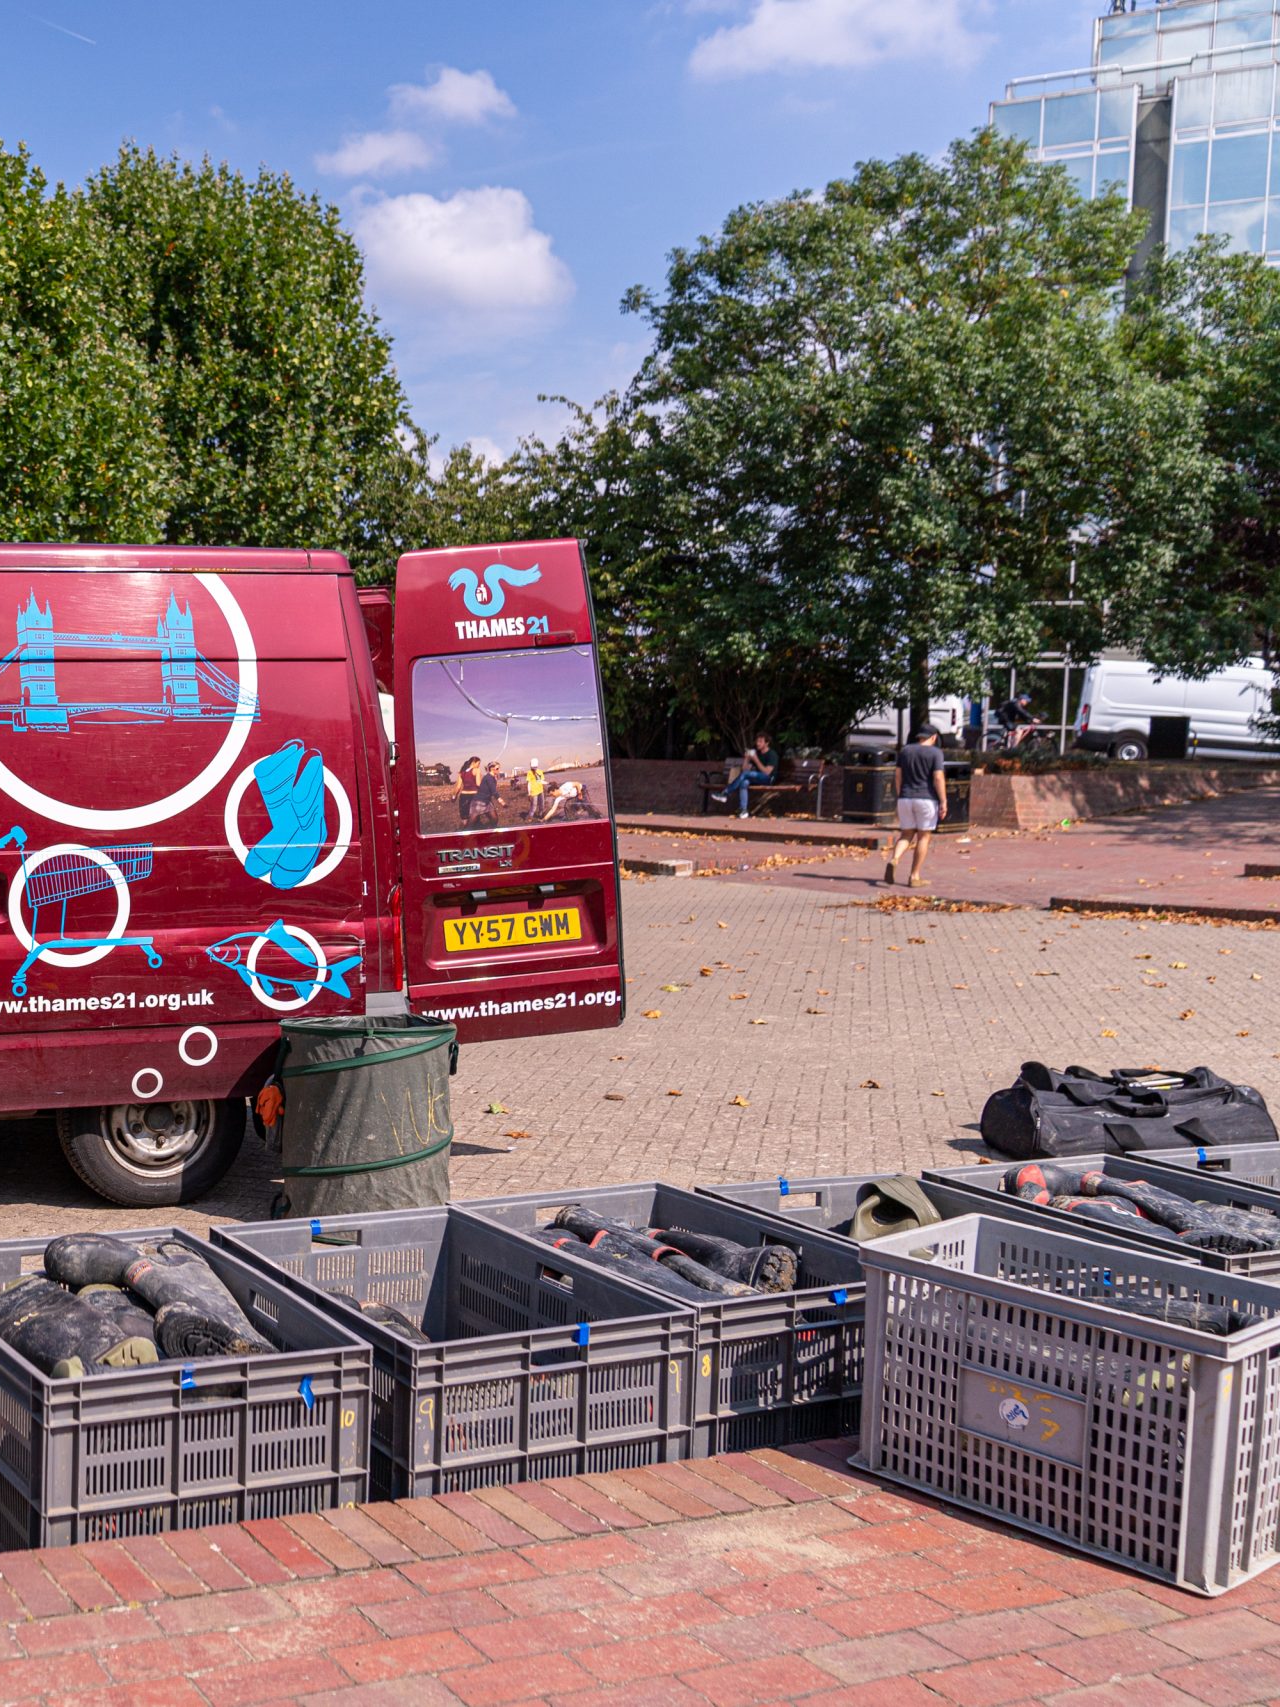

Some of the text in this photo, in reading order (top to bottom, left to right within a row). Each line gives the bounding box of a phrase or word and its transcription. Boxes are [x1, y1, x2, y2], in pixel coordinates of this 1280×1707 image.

[454, 615, 549, 640] THAMES 21
[437, 844, 514, 863] TRANSIT
[453, 912, 570, 946] YY57 GWM
[669, 1360, 679, 1393] 9
[701, 1354, 711, 1377] 8
[420, 1398, 433, 1431] 9
